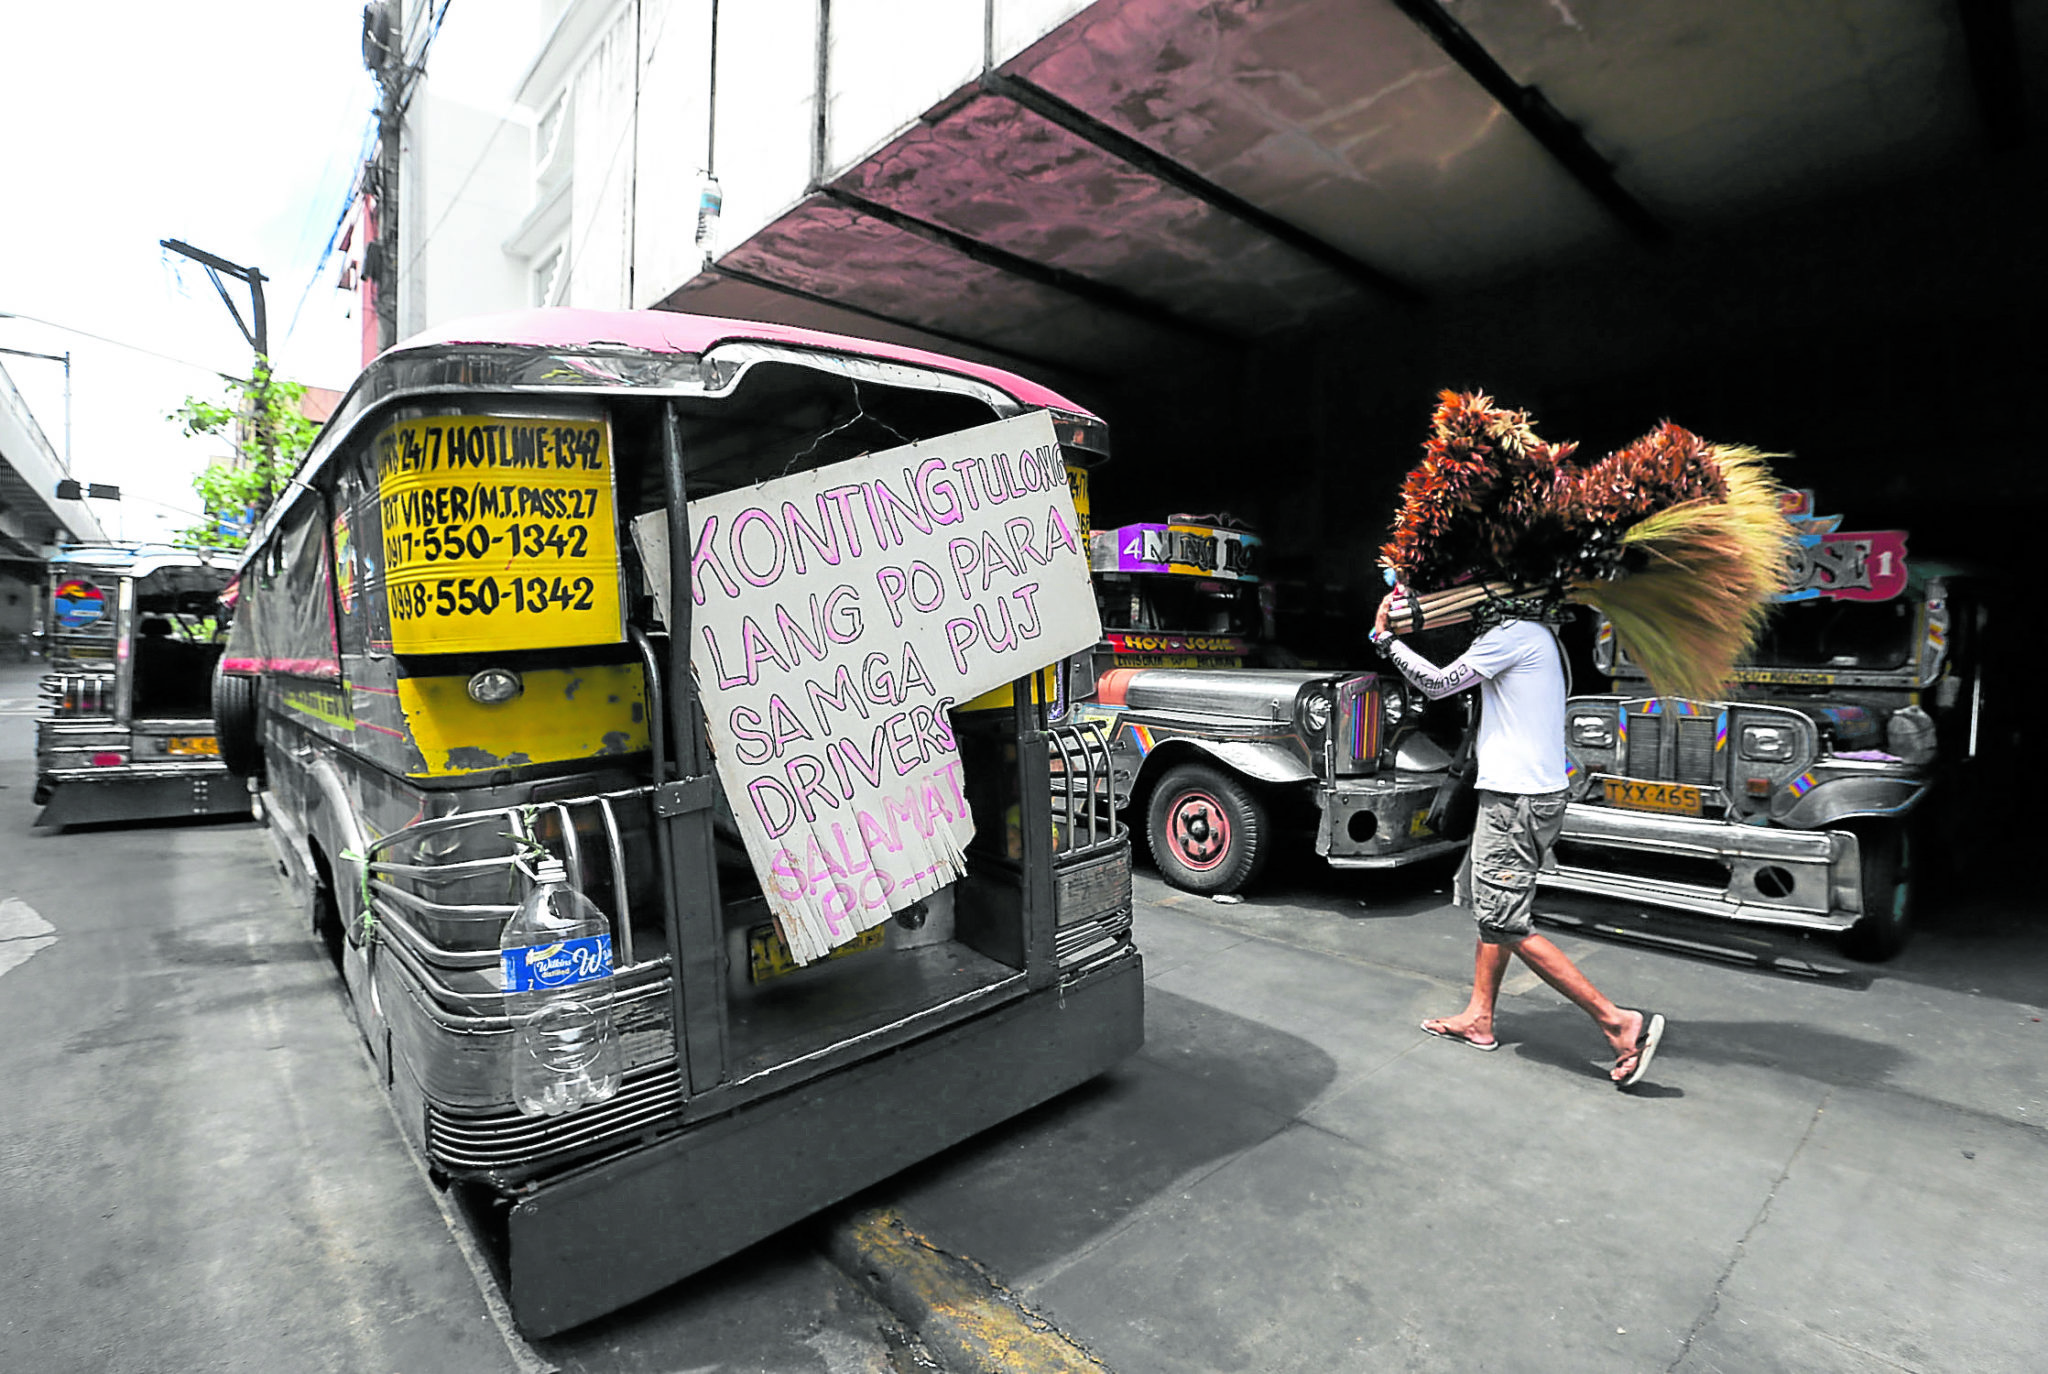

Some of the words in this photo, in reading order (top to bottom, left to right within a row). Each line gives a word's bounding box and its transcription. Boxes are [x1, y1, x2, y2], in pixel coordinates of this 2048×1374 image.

[400, 426, 443, 473] 24/7
[690, 457, 964, 606] KONTING
[953, 443, 1069, 511] TULONG
[1876, 551, 1896, 577] 1
[702, 584, 865, 691] LANG
[876, 560, 945, 628] PO
[948, 505, 1078, 600] PARA
[944, 583, 1042, 675] PUJ
[746, 696, 957, 840] DRIVERS
[771, 759, 968, 901] SALAMAT
[536, 958, 573, 974] Wilkins
